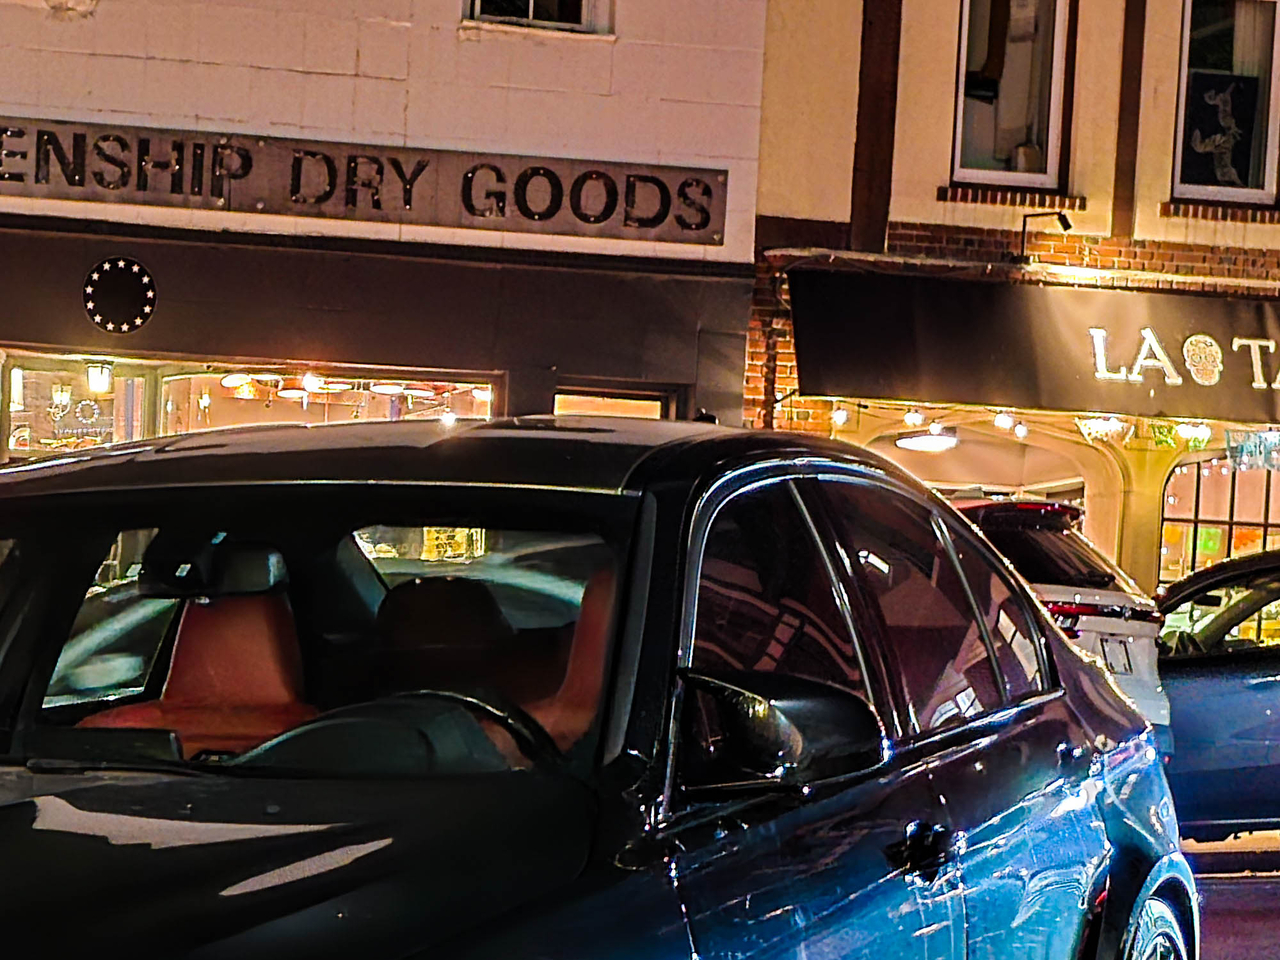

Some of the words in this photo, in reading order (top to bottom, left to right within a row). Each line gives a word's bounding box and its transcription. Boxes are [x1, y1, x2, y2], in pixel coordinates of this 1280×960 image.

[291, 148, 430, 211] DRY
[461, 162, 713, 231] GOODS
[1088, 326, 1183, 386] LA
[1231, 336, 1280, 390] T
